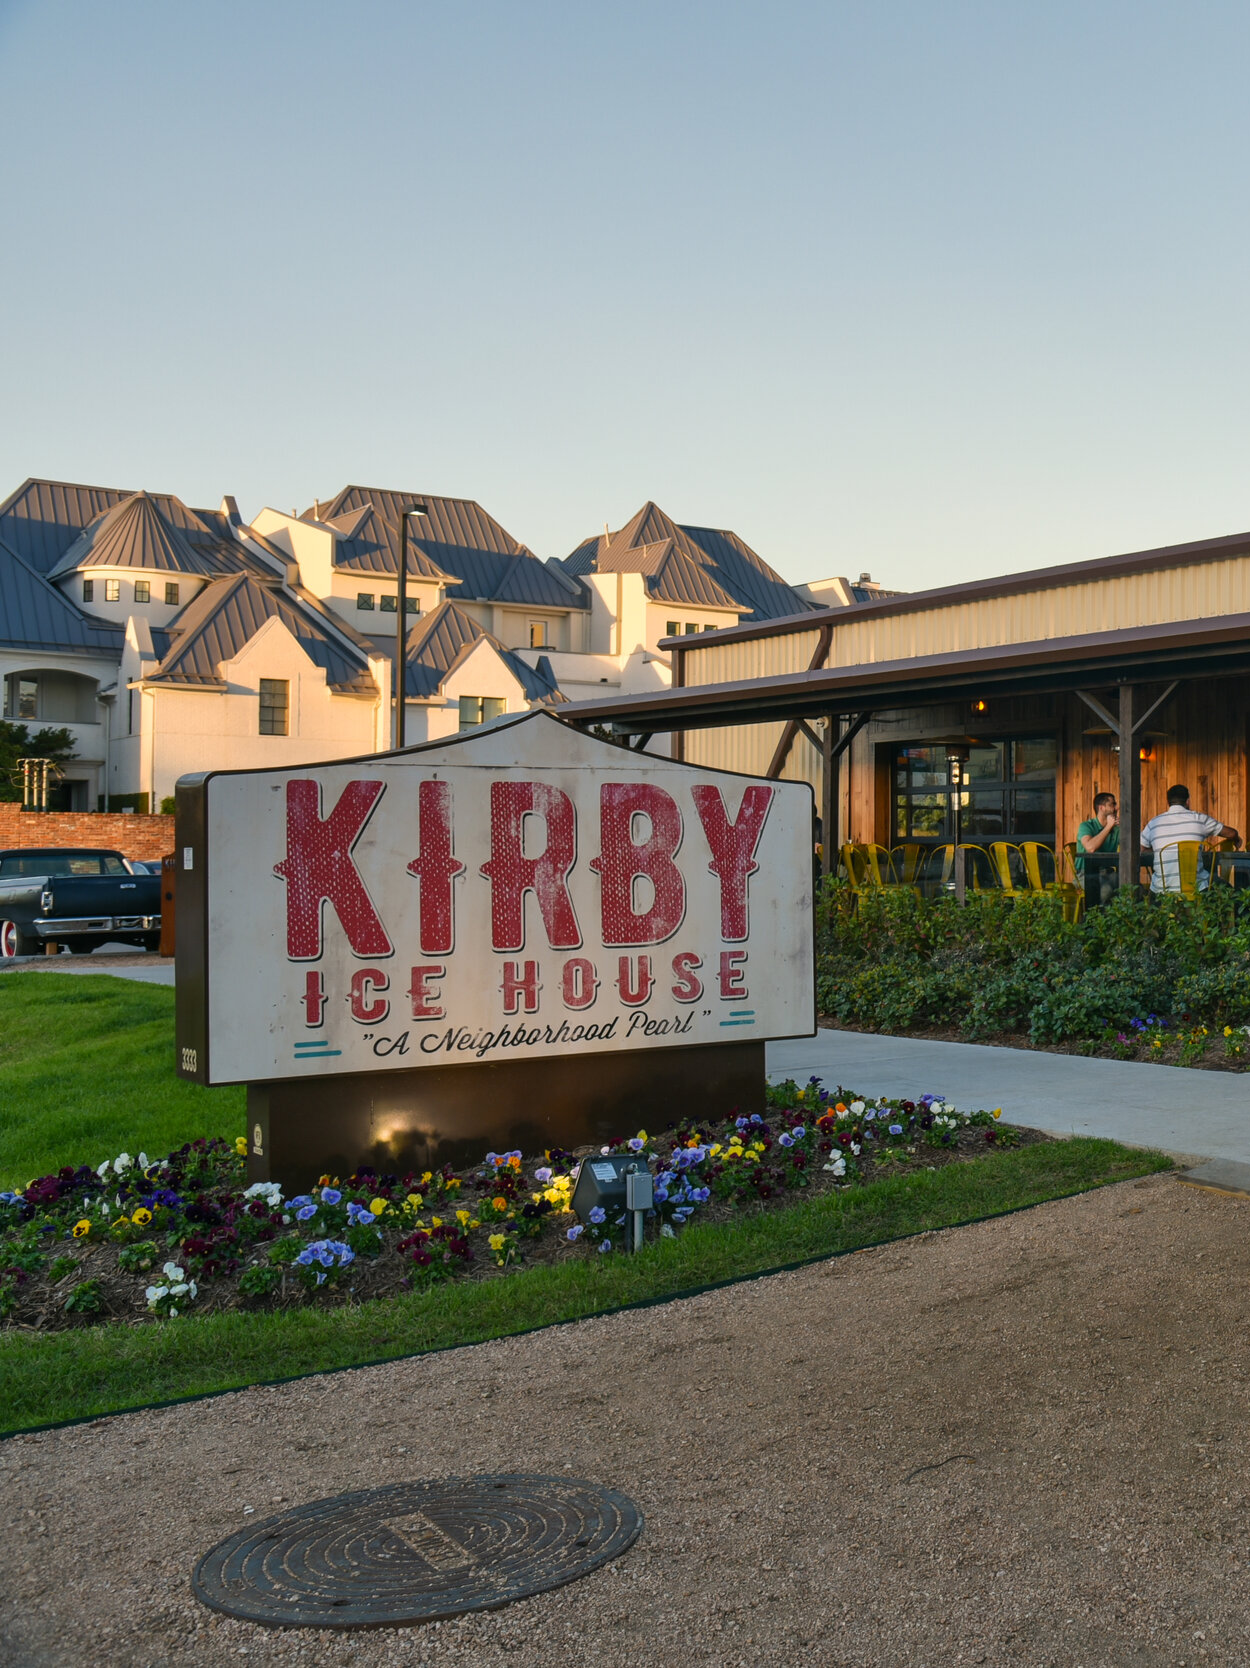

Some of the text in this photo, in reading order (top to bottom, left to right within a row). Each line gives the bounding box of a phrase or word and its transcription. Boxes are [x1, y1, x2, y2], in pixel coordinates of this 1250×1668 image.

[273, 779, 775, 961] KIRBY
[300, 950, 750, 1029] ICE HOUSE
[182, 1047, 197, 1073] 3333
[420, 1016, 619, 1057] Neighborhood
